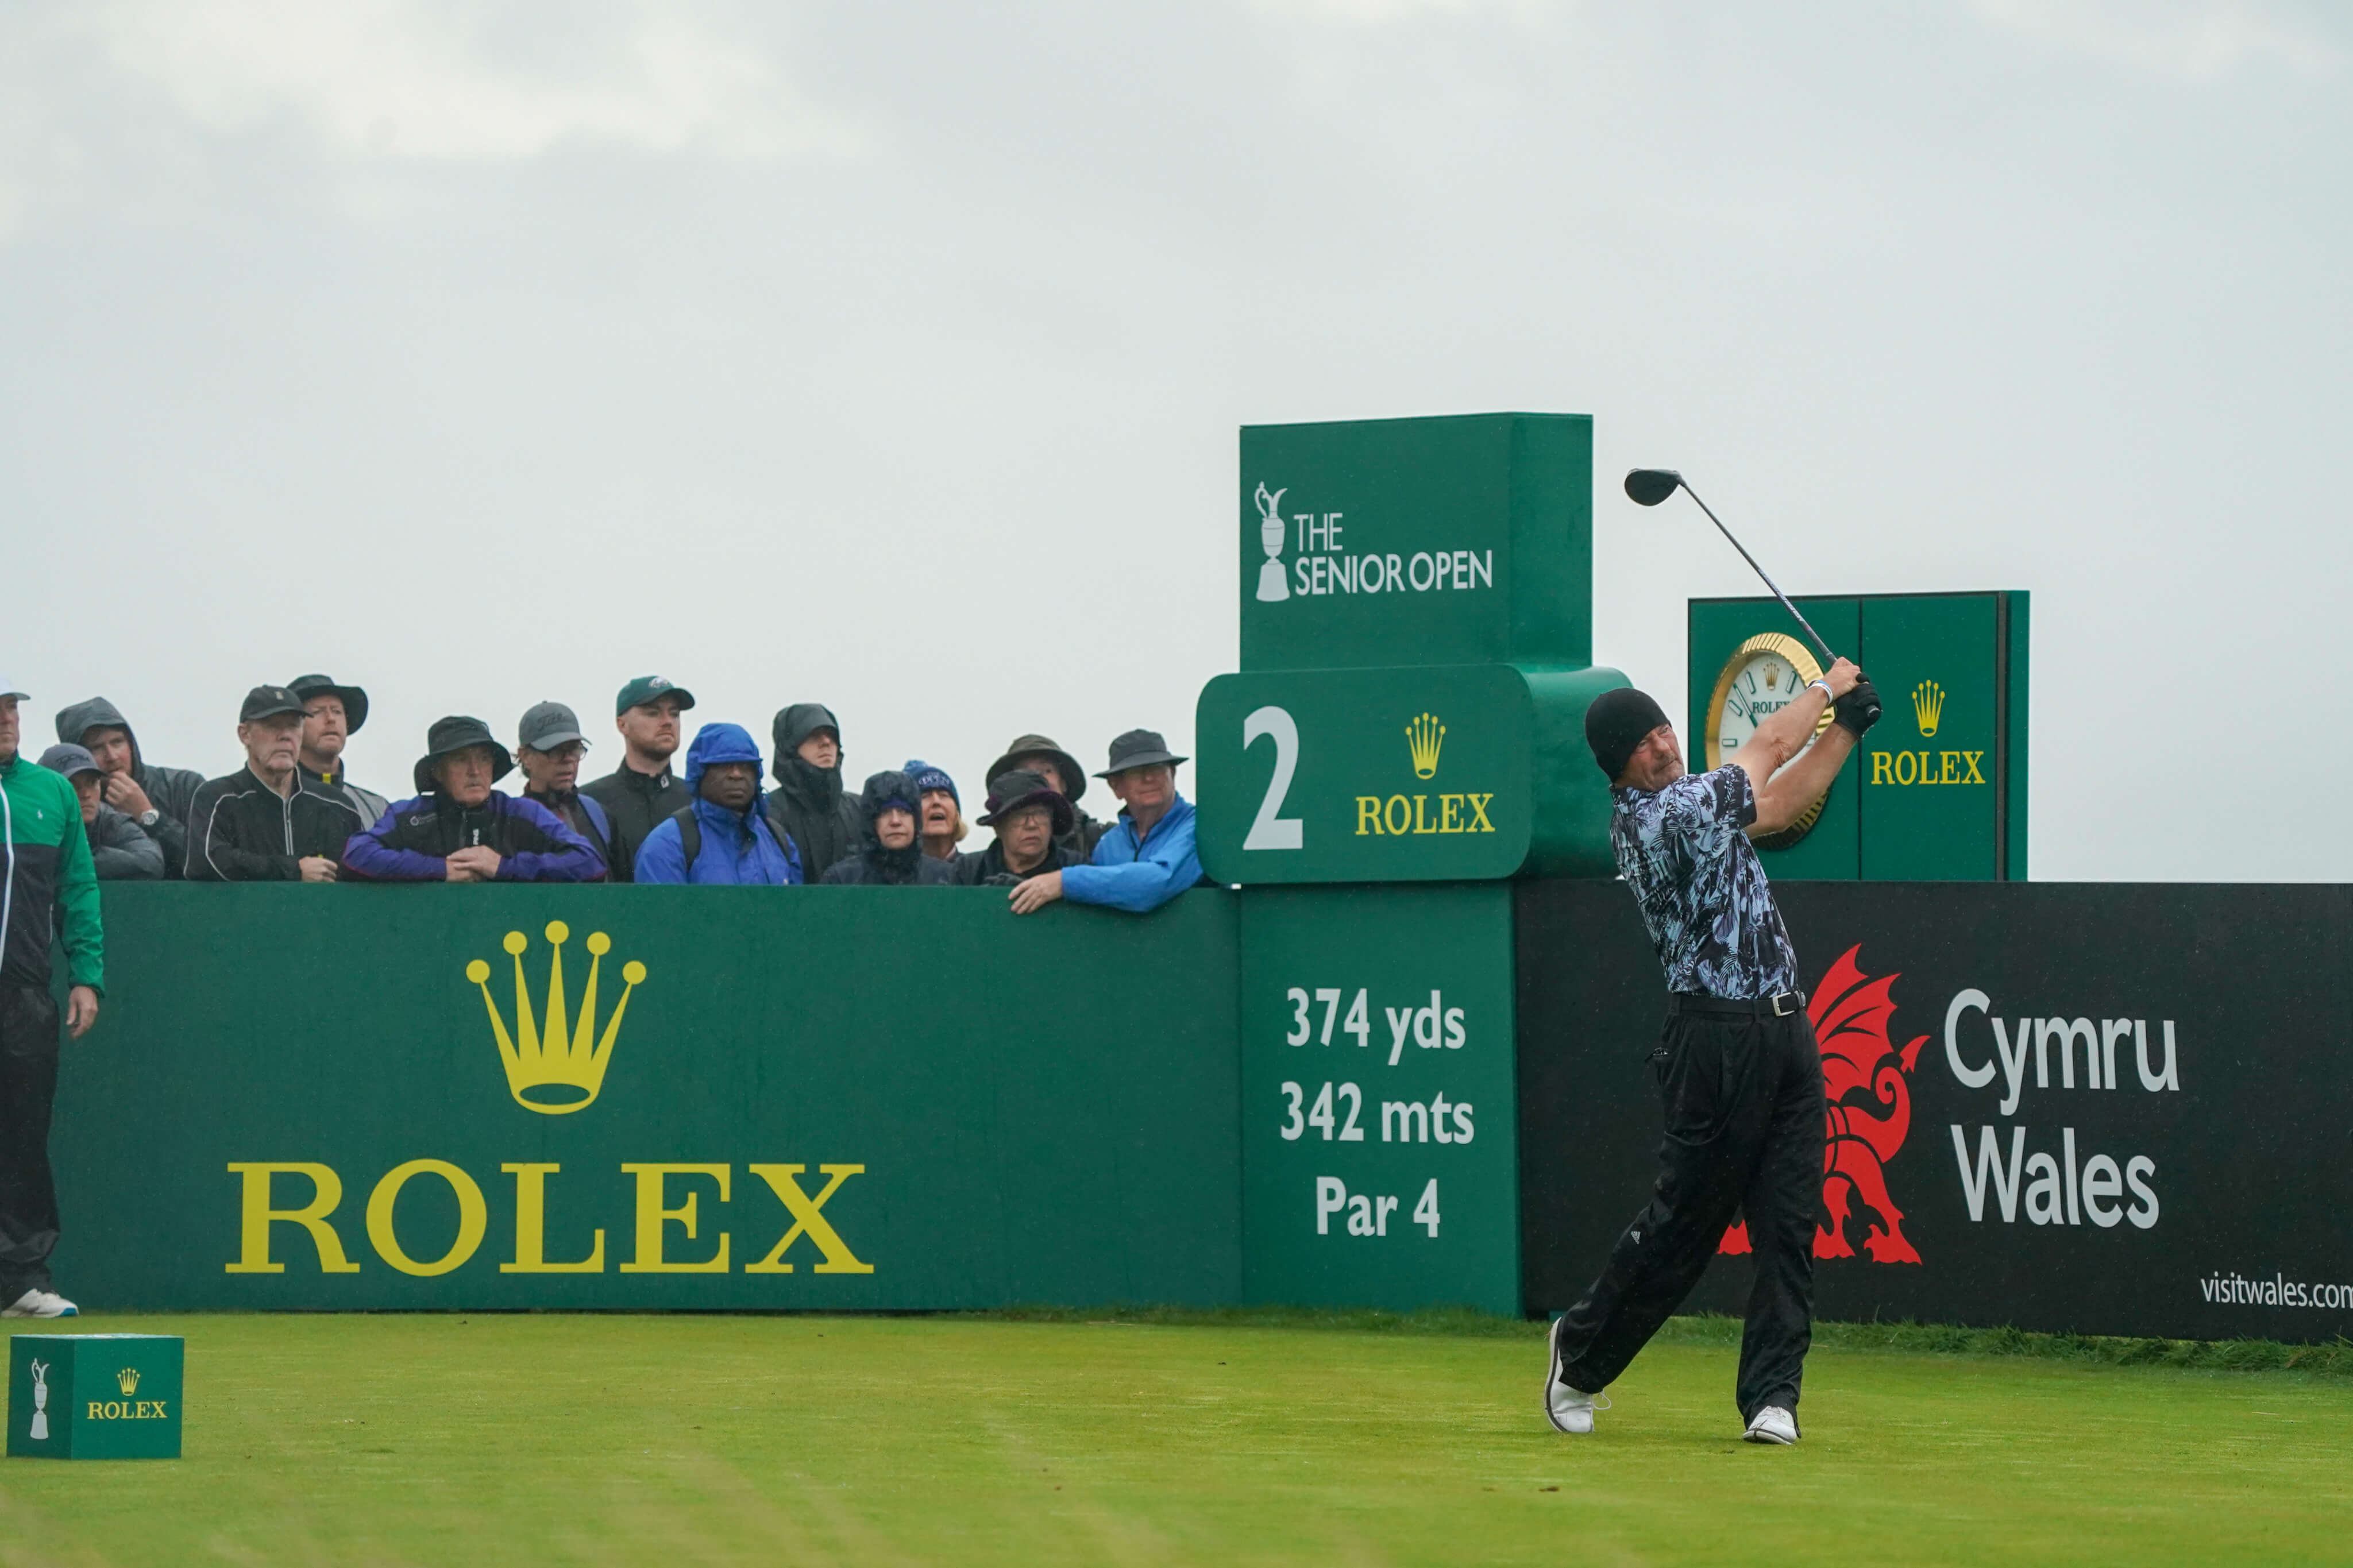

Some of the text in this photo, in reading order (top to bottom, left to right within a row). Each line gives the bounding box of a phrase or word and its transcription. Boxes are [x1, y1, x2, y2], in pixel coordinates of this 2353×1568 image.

[1294, 513, 1343, 552] THE
[1295, 550, 1492, 596] SENIOR OPEN
[1243, 706, 1303, 851] 2
[1871, 750, 1986, 785] ROLEX
[1355, 793, 1496, 836] ROLEX
[1287, 987, 1466, 1066] 374 yds
[1944, 988, 2180, 1117] Cymru
[1280, 1081, 1475, 1145] 342 mts
[1316, 1176, 1441, 1238] Par 4
[1950, 1124, 2159, 1229] Wales
[225, 1158, 875, 1277] ROLEX
[87, 1401, 168, 1420] ROLEX
